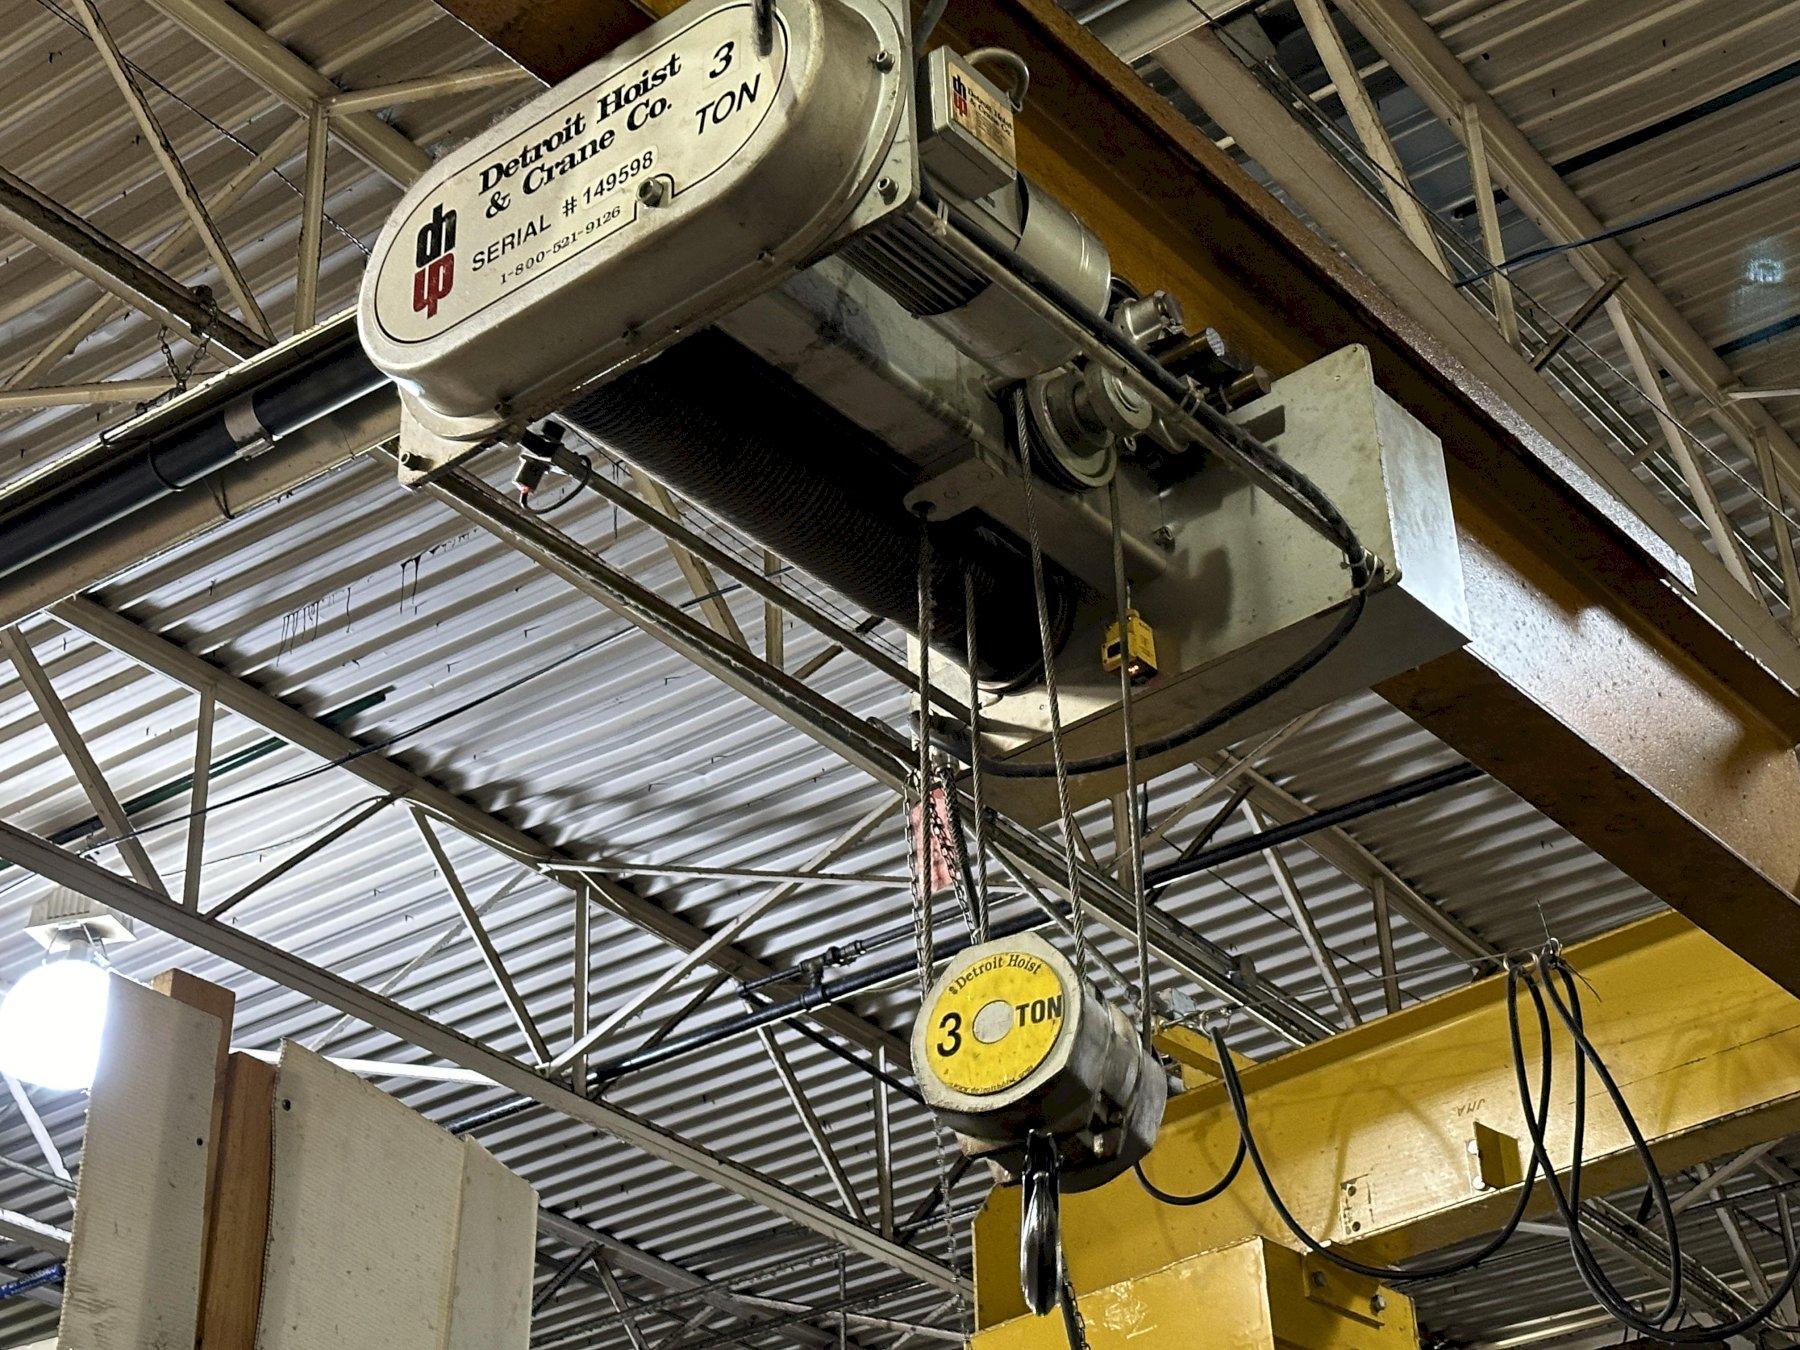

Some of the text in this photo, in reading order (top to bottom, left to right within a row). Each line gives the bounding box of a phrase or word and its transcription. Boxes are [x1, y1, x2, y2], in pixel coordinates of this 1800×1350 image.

[709, 41, 735, 79] 3
[479, 53, 682, 196] Detroit Hoist
[695, 72, 761, 136] TON
[485, 97, 673, 219] & Crane Co.
[472, 214, 552, 272] SERIAL
[500, 205, 621, 286] 1-800-521-9126
[955, 954, 1042, 990] Detroit Hoist
[936, 994, 1062, 1057] 3 TON
